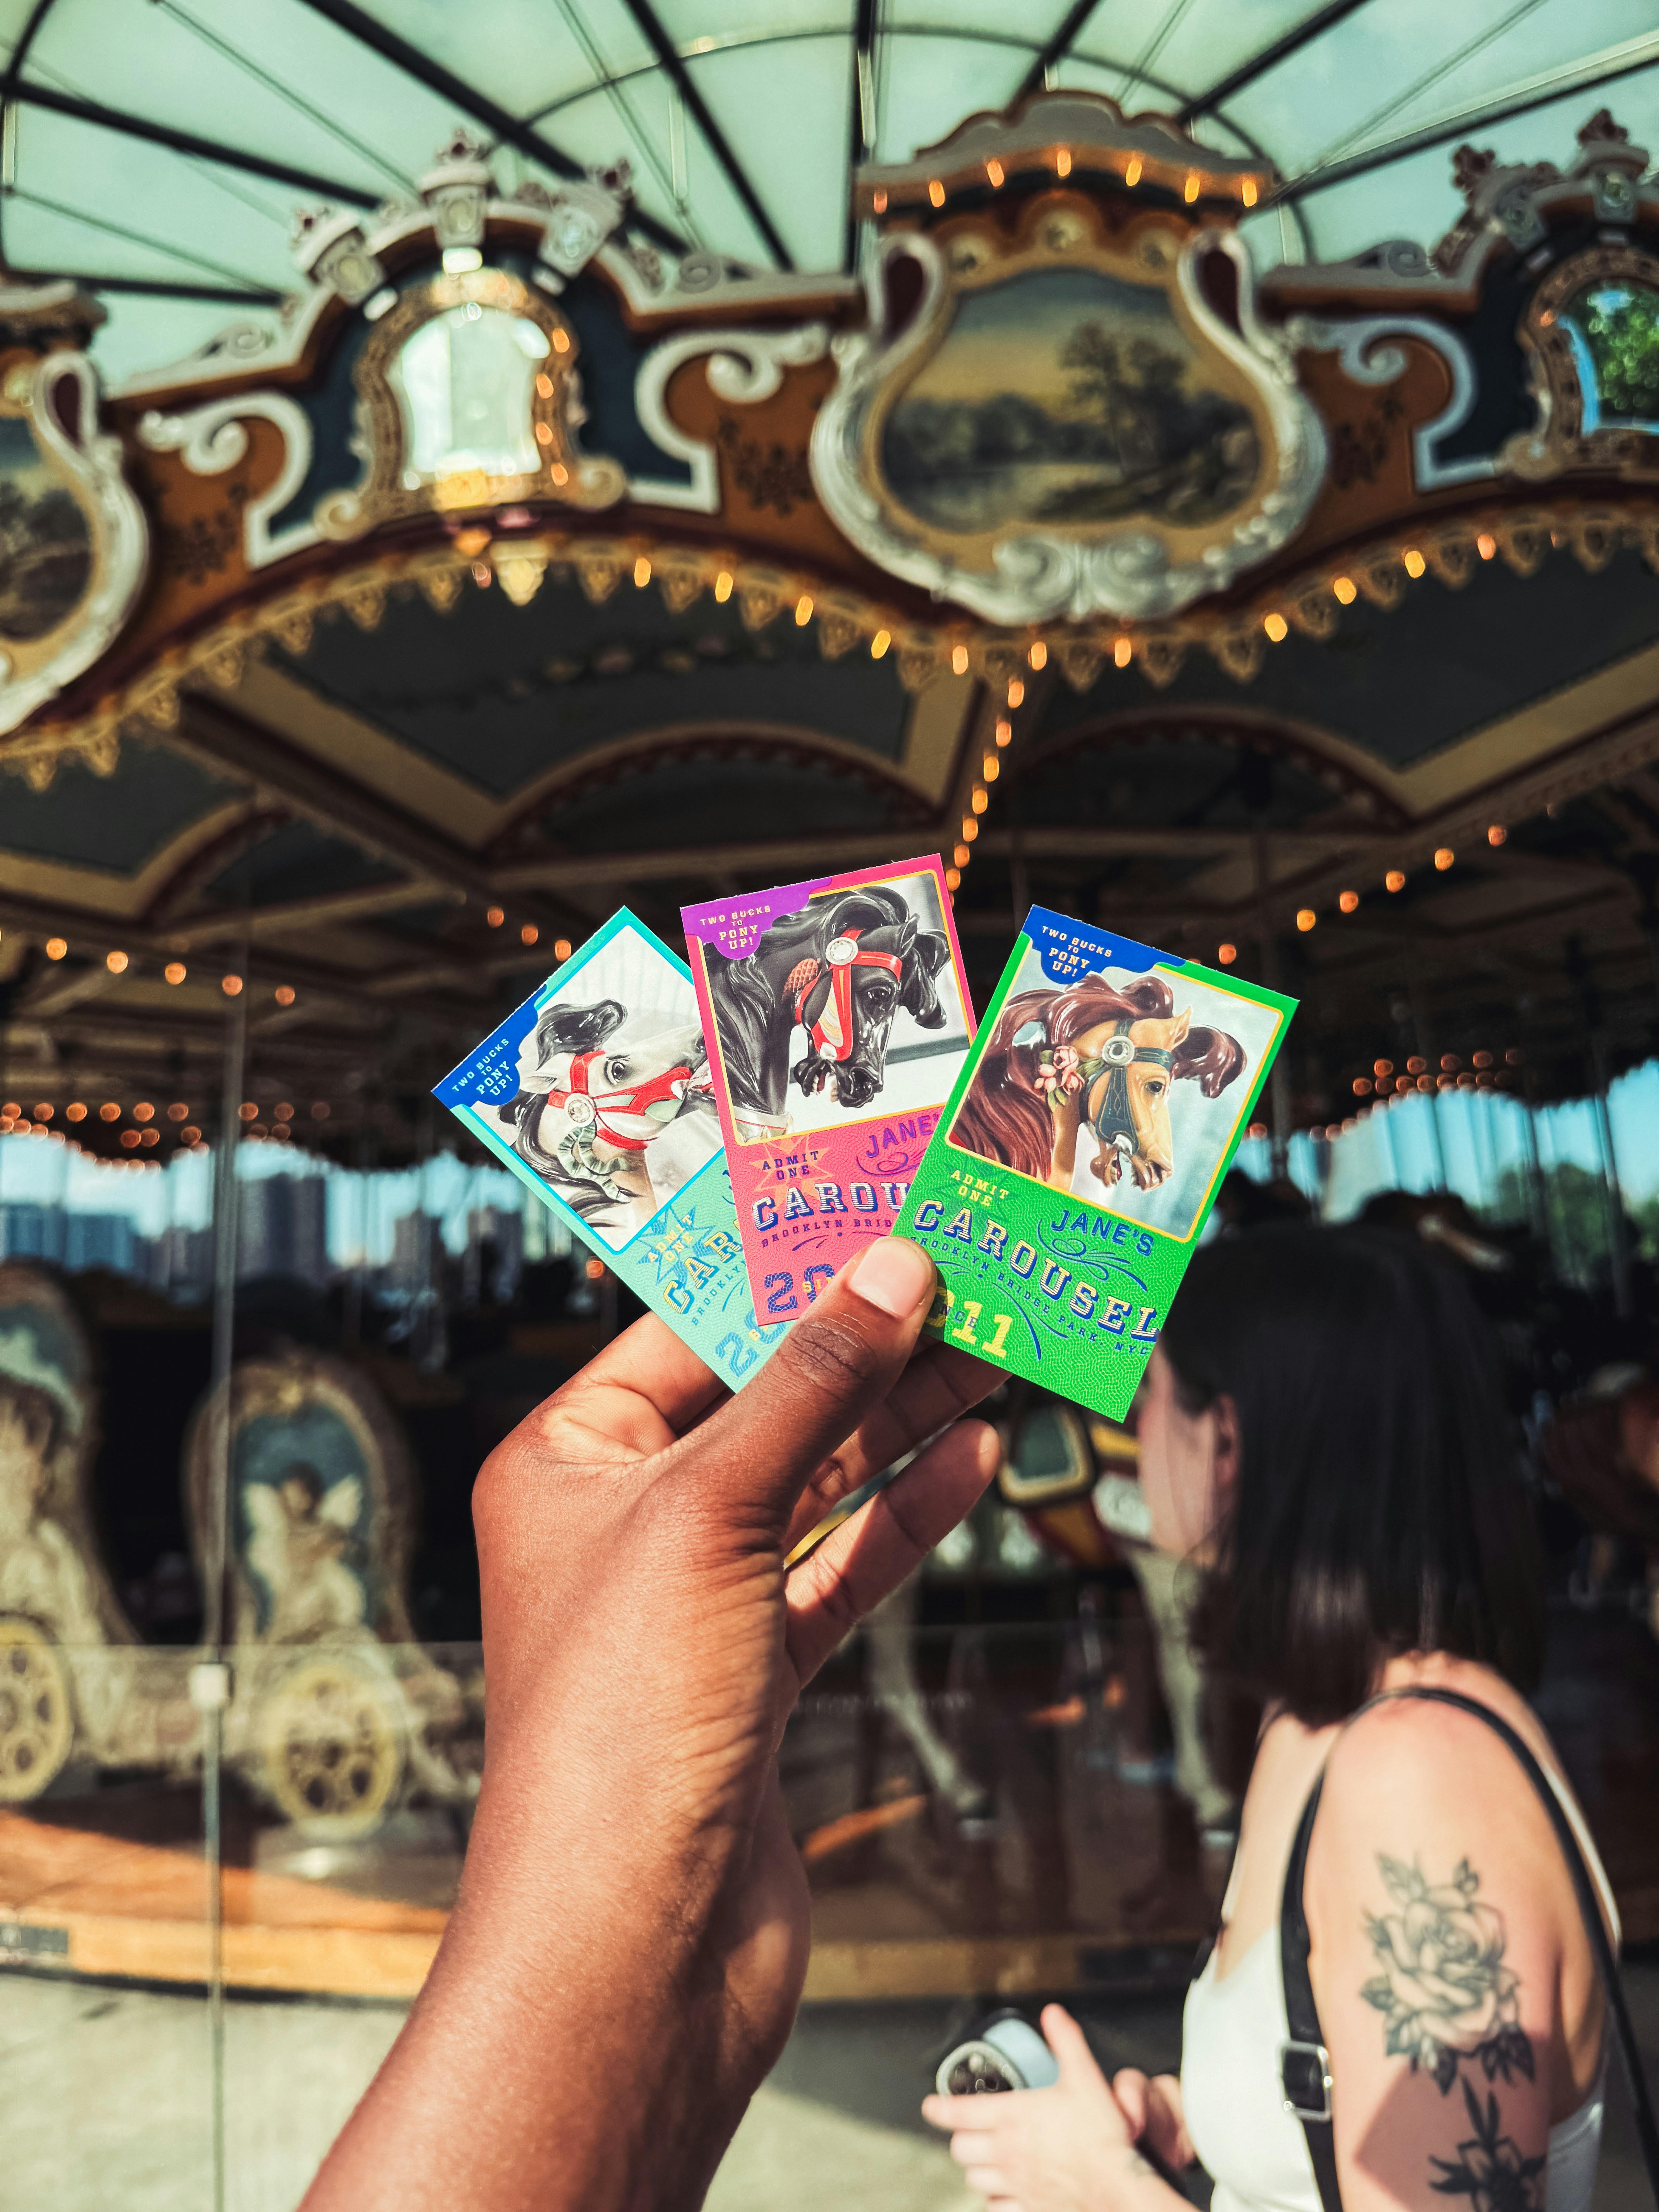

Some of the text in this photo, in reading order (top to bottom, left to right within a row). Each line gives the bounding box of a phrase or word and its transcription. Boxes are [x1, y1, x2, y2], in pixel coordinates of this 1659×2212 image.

[700, 905, 771, 926] TWO BUCKS
[719, 924, 758, 941] PONY
[728, 936, 753, 950] UP!
[1042, 926, 1112, 957] TWO BUCKS
[1048, 947, 1090, 969] PONY
[1068, 945, 1079, 953] TO
[1052, 960, 1078, 977] UP!
[452, 1038, 509, 1092] TWO BUCKS
[481, 1065, 492, 1075] TO
[476, 1061, 510, 1095] PONY
[489, 1074, 513, 1096] UP!
[762, 1151, 819, 1171] ADMIT
[776, 1165, 811, 1180] ONE
[950, 1169, 1010, 1200] ADMIT
[958, 1185, 991, 1207] ONE
[647, 1214, 692, 1263] ADMIT
[762, 1219, 842, 1248] BROOKLYN
[1051, 1209, 1154, 1257] JANE'S
[664, 1231, 693, 1262] ONE
[663, 1218, 744, 1314] CAR
[913, 1199, 1161, 1343] CAROUSEL
[997, 1271, 1050, 1314] BRIDGE
[1114, 1341, 1149, 1355] NYC
